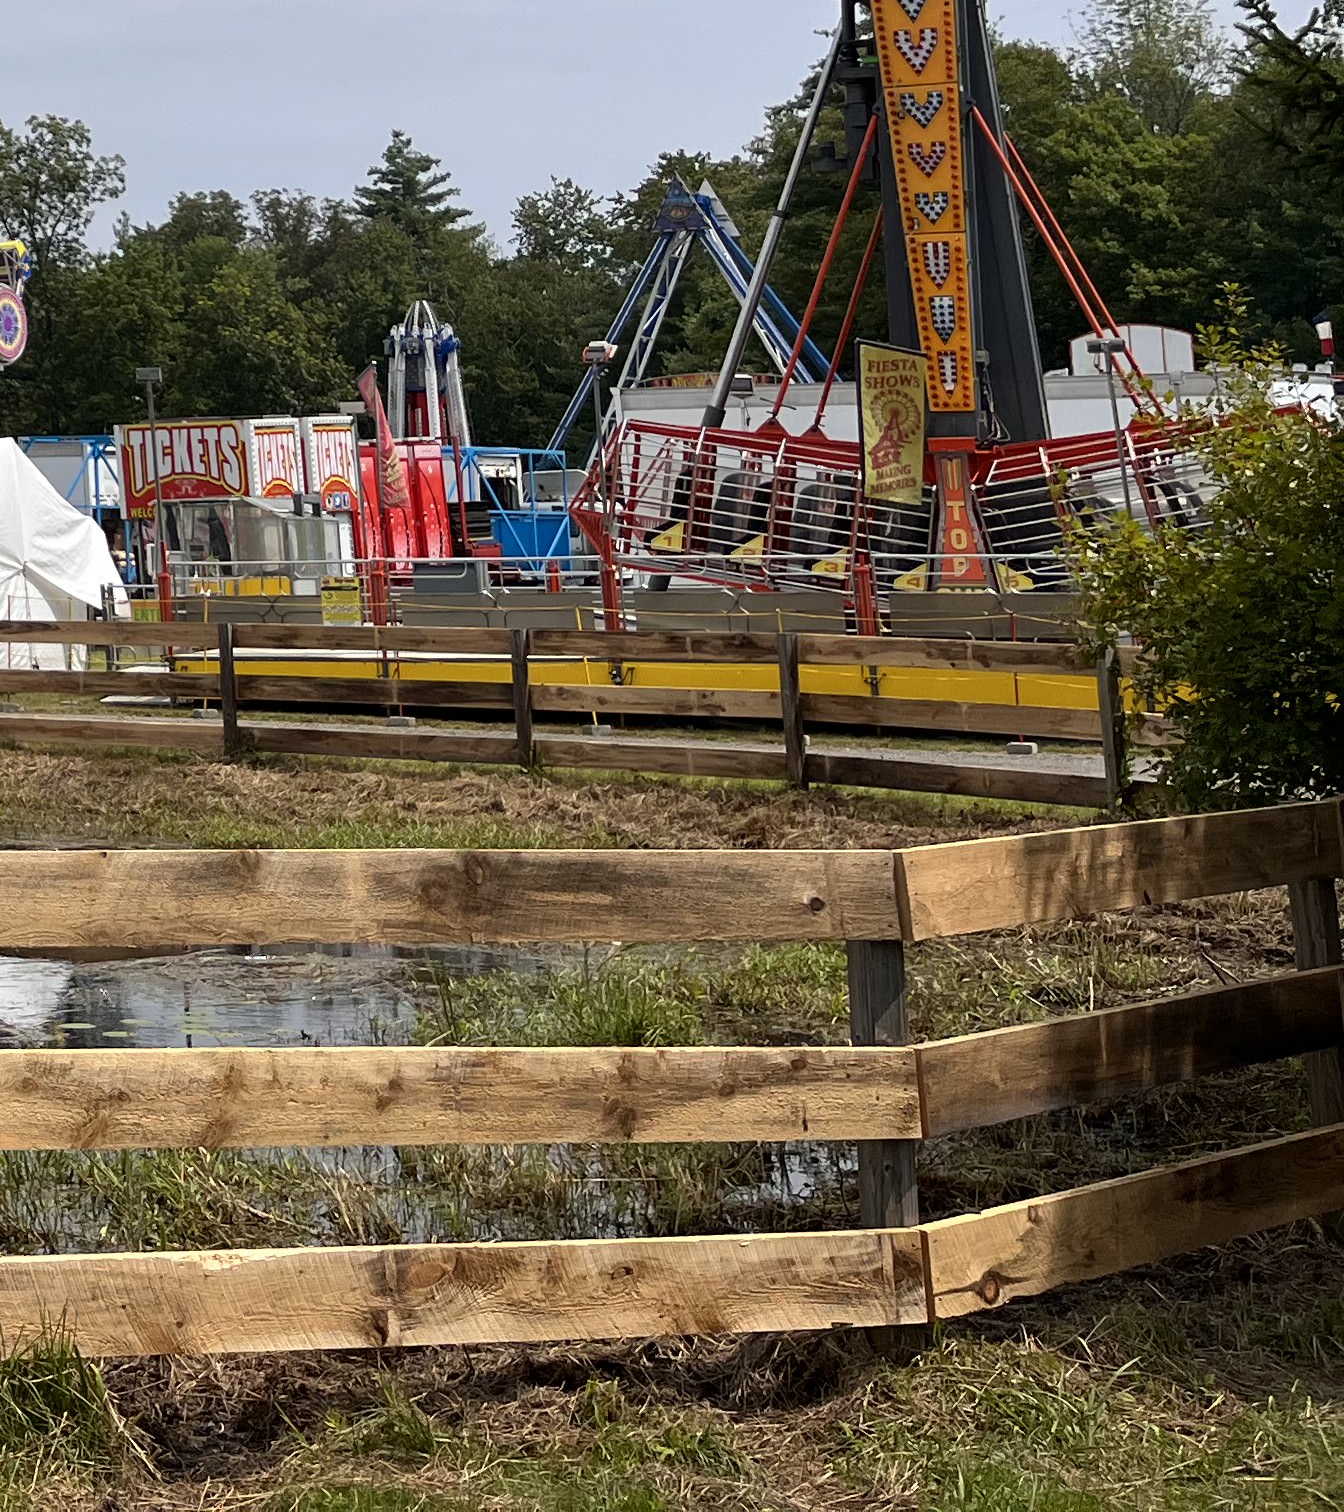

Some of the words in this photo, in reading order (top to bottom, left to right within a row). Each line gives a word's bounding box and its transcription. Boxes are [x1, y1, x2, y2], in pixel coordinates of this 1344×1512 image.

[864, 374, 920, 389] SHOWS
[867, 359, 918, 373] FIESTA
[128, 424, 242, 492] TICKETS
[254, 433, 299, 493] TICKETS
[312, 431, 357, 494] TICKETS
